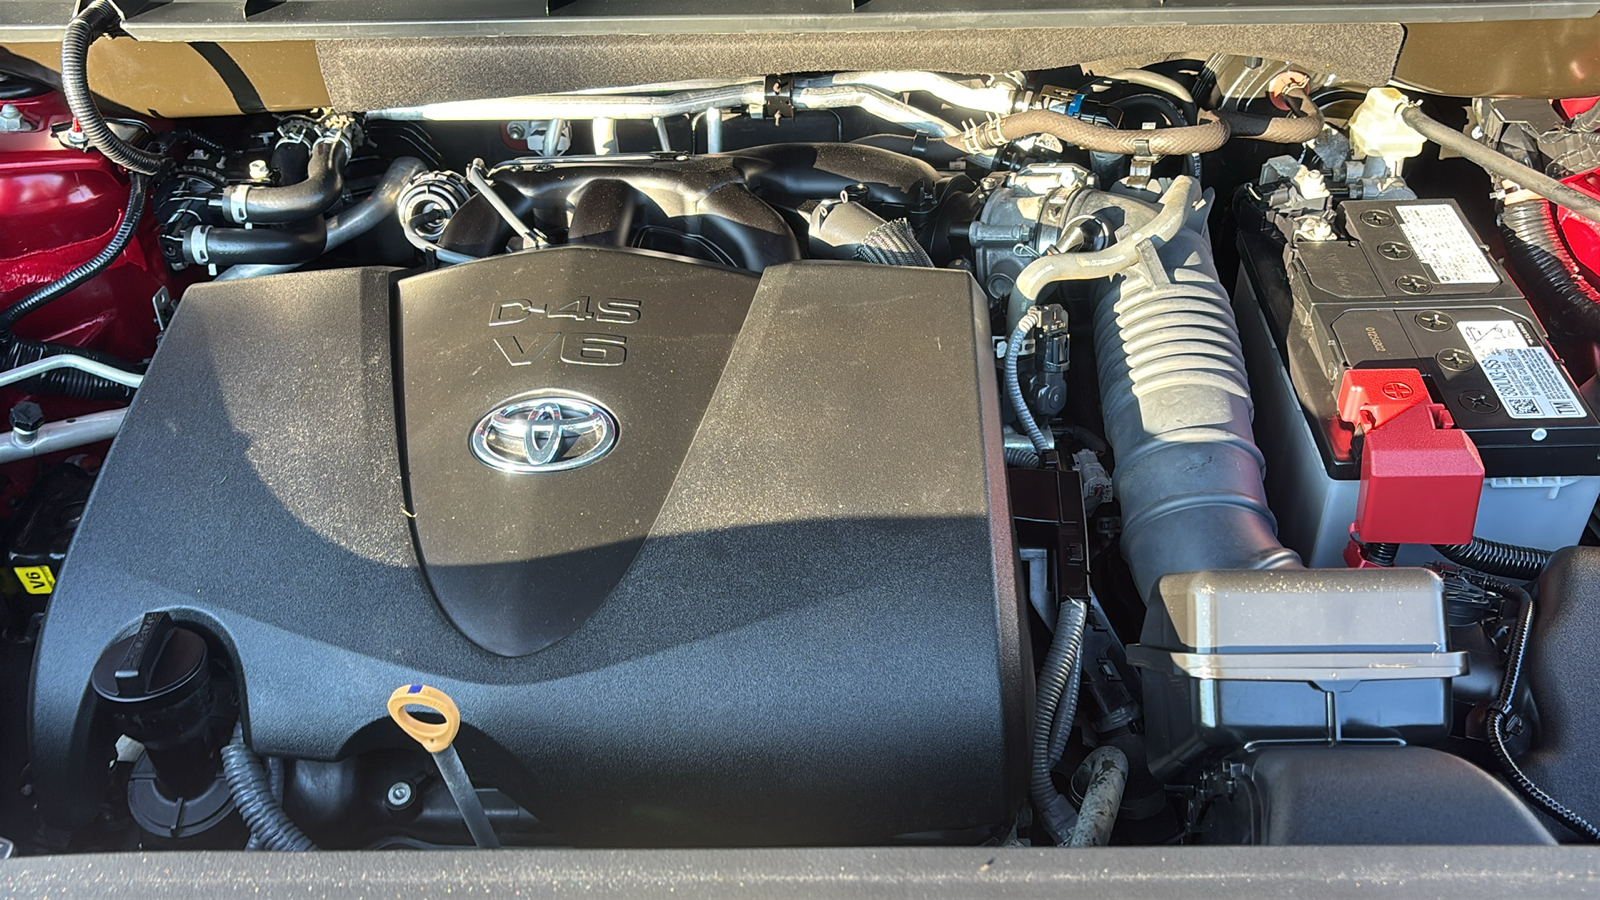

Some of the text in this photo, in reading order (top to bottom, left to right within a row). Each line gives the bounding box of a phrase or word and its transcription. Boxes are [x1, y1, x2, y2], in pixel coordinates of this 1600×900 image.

[489, 296, 641, 326] D-4S
[493, 332, 627, 366] V6
[1552, 402, 1576, 414] TM
[26, 571, 45, 589] V6
